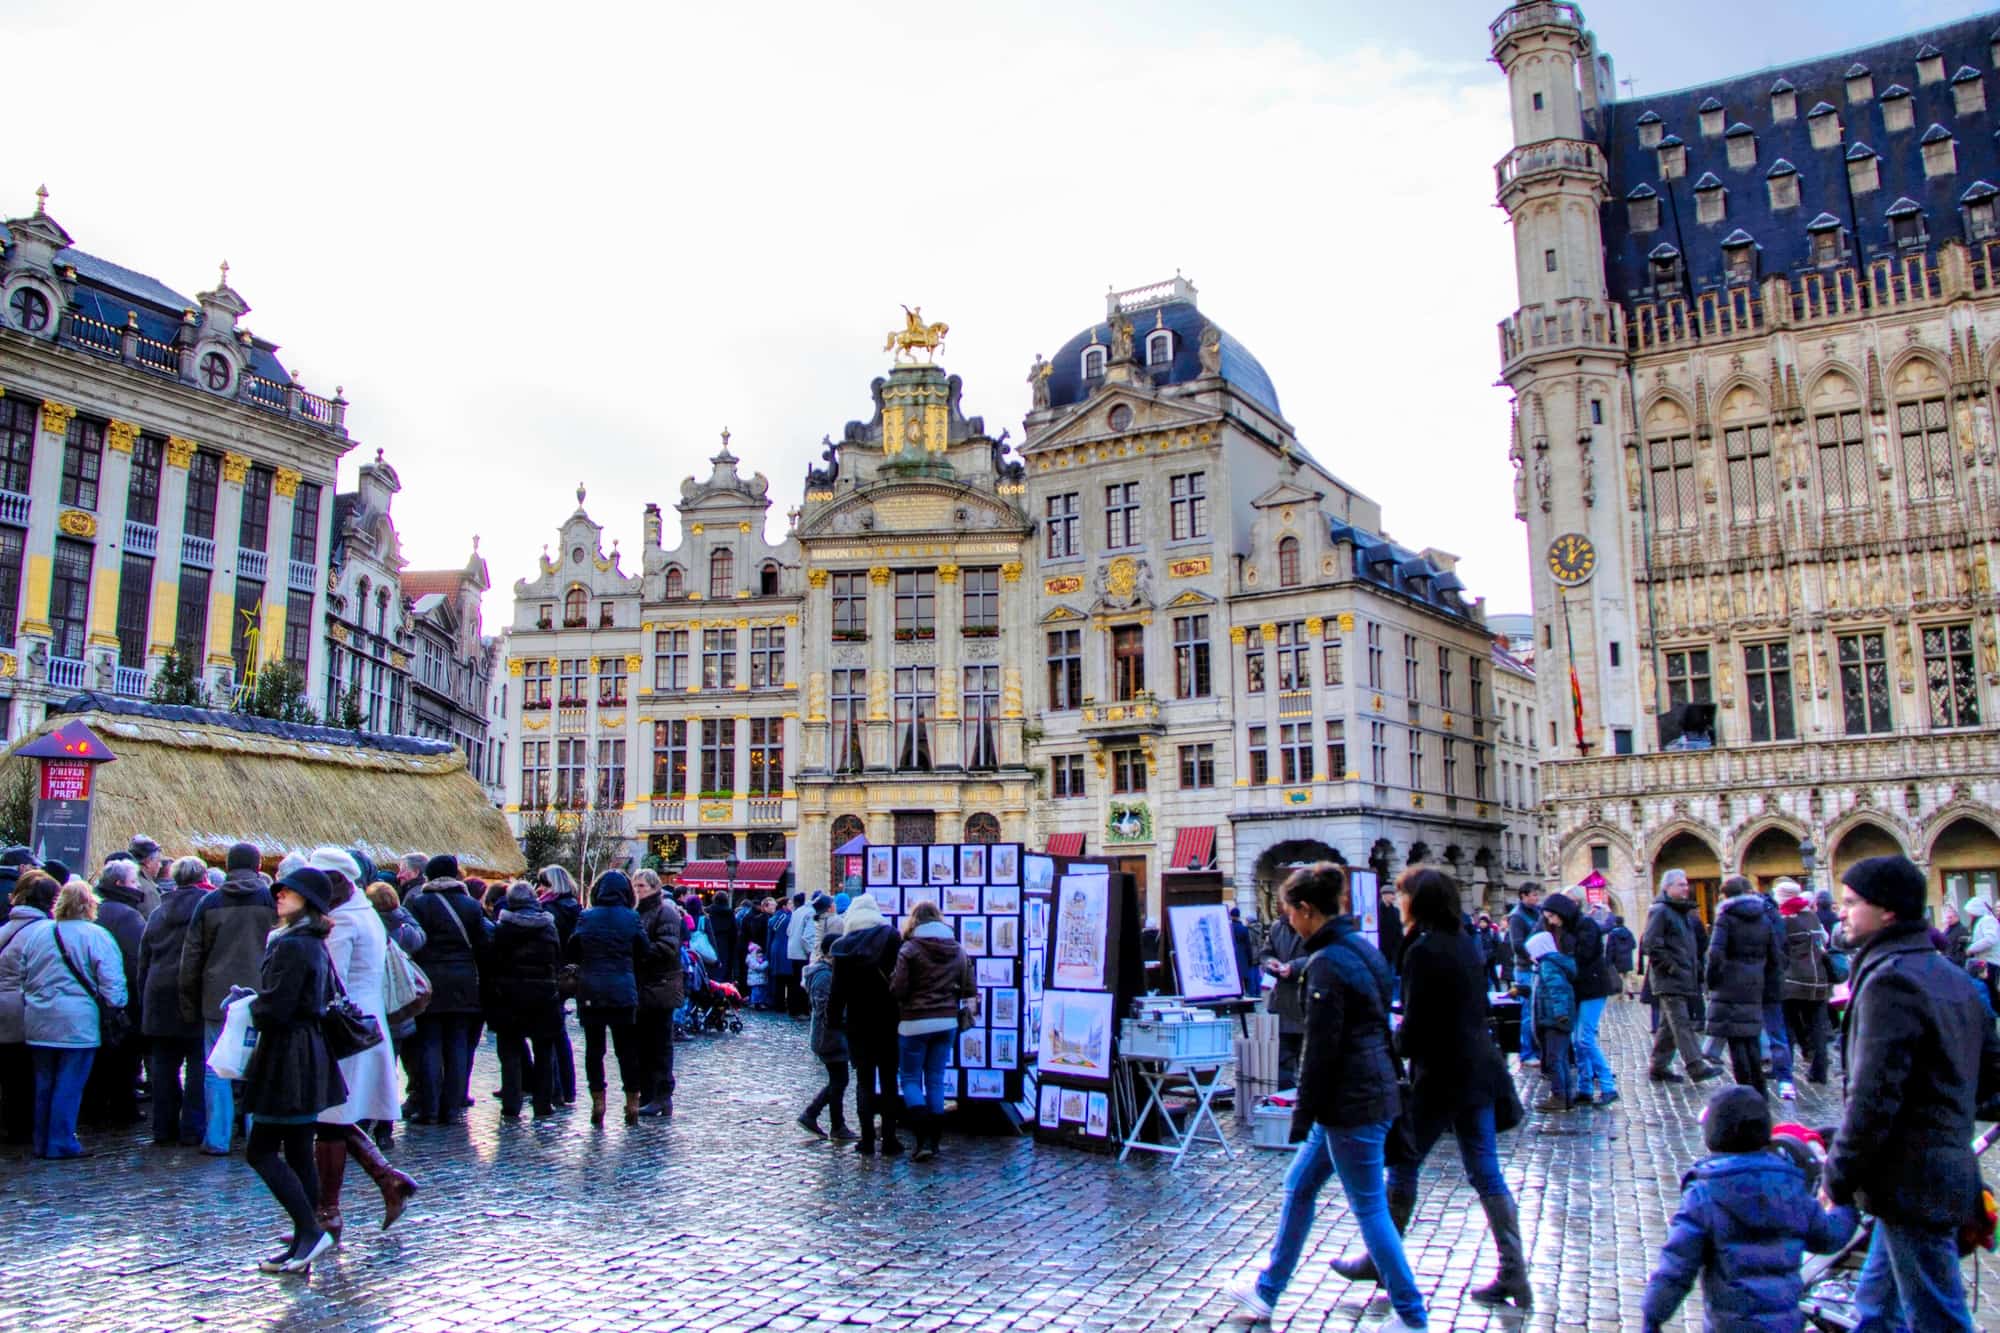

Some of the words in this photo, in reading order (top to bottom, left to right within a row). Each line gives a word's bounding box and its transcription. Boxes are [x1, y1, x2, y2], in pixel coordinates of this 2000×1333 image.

[997, 484, 1025, 495] 1698
[807, 491, 834, 502] ANNO
[50, 780, 83, 790] WINTER
